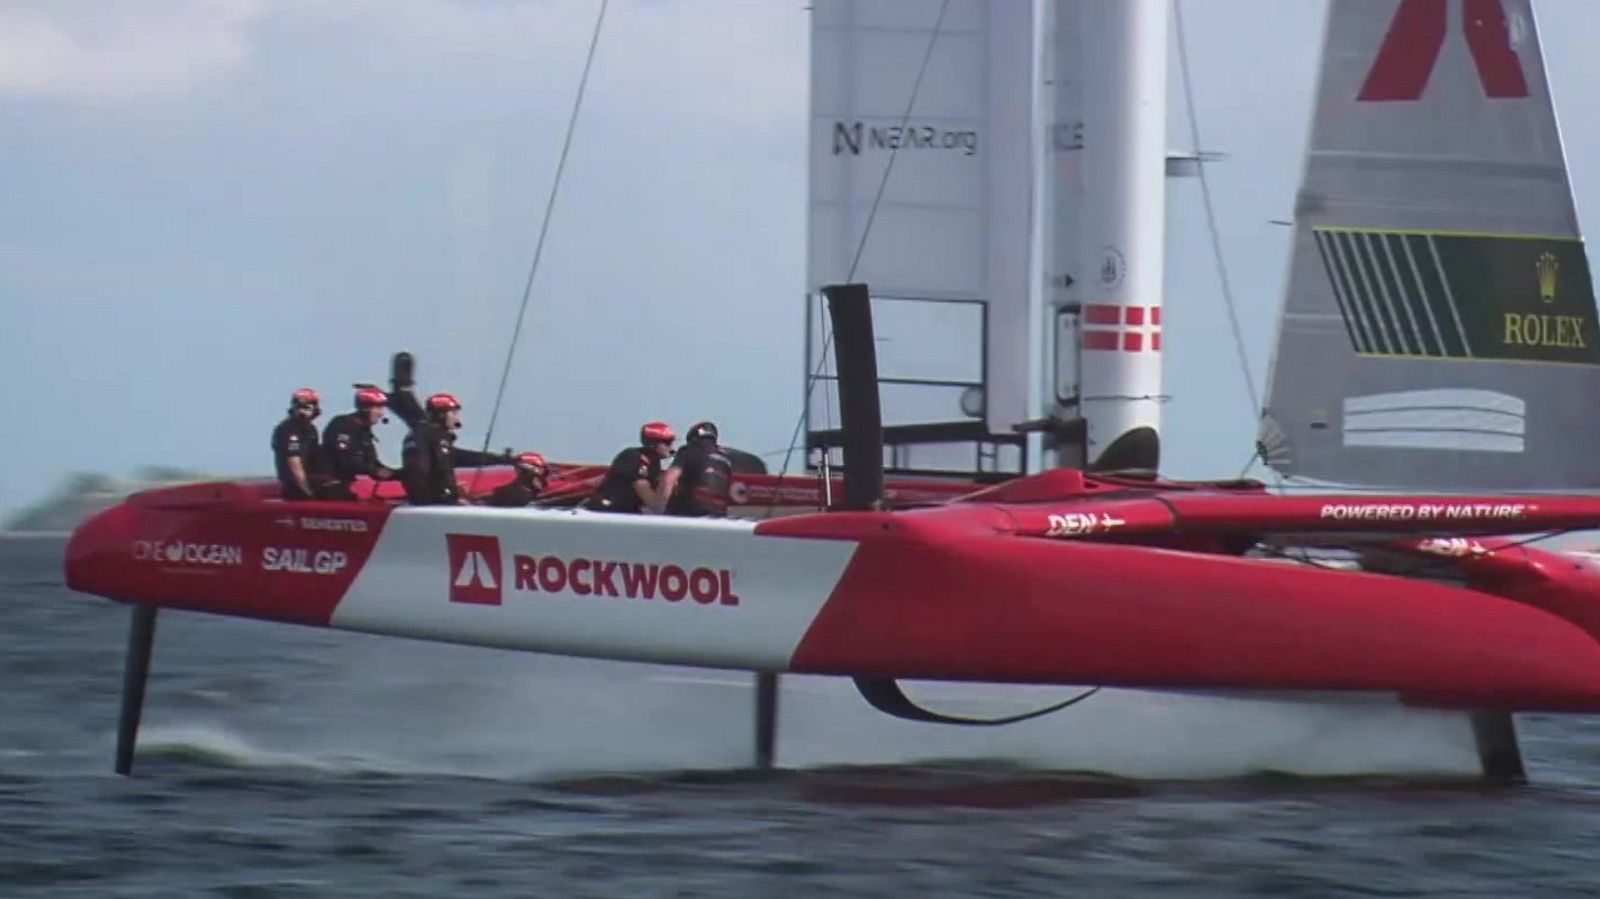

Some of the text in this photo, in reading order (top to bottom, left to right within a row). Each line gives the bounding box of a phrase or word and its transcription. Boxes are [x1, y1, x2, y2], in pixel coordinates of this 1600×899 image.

[868, 126, 977, 156] NEAR.org
[1502, 312, 1586, 348] ROLEX
[1046, 513, 1097, 536] DEN
[1321, 504, 1414, 520] POWERED
[1418, 505, 1442, 519] BY
[185, 544, 242, 565] OCEAN
[514, 554, 739, 606] ROCKWOOL
